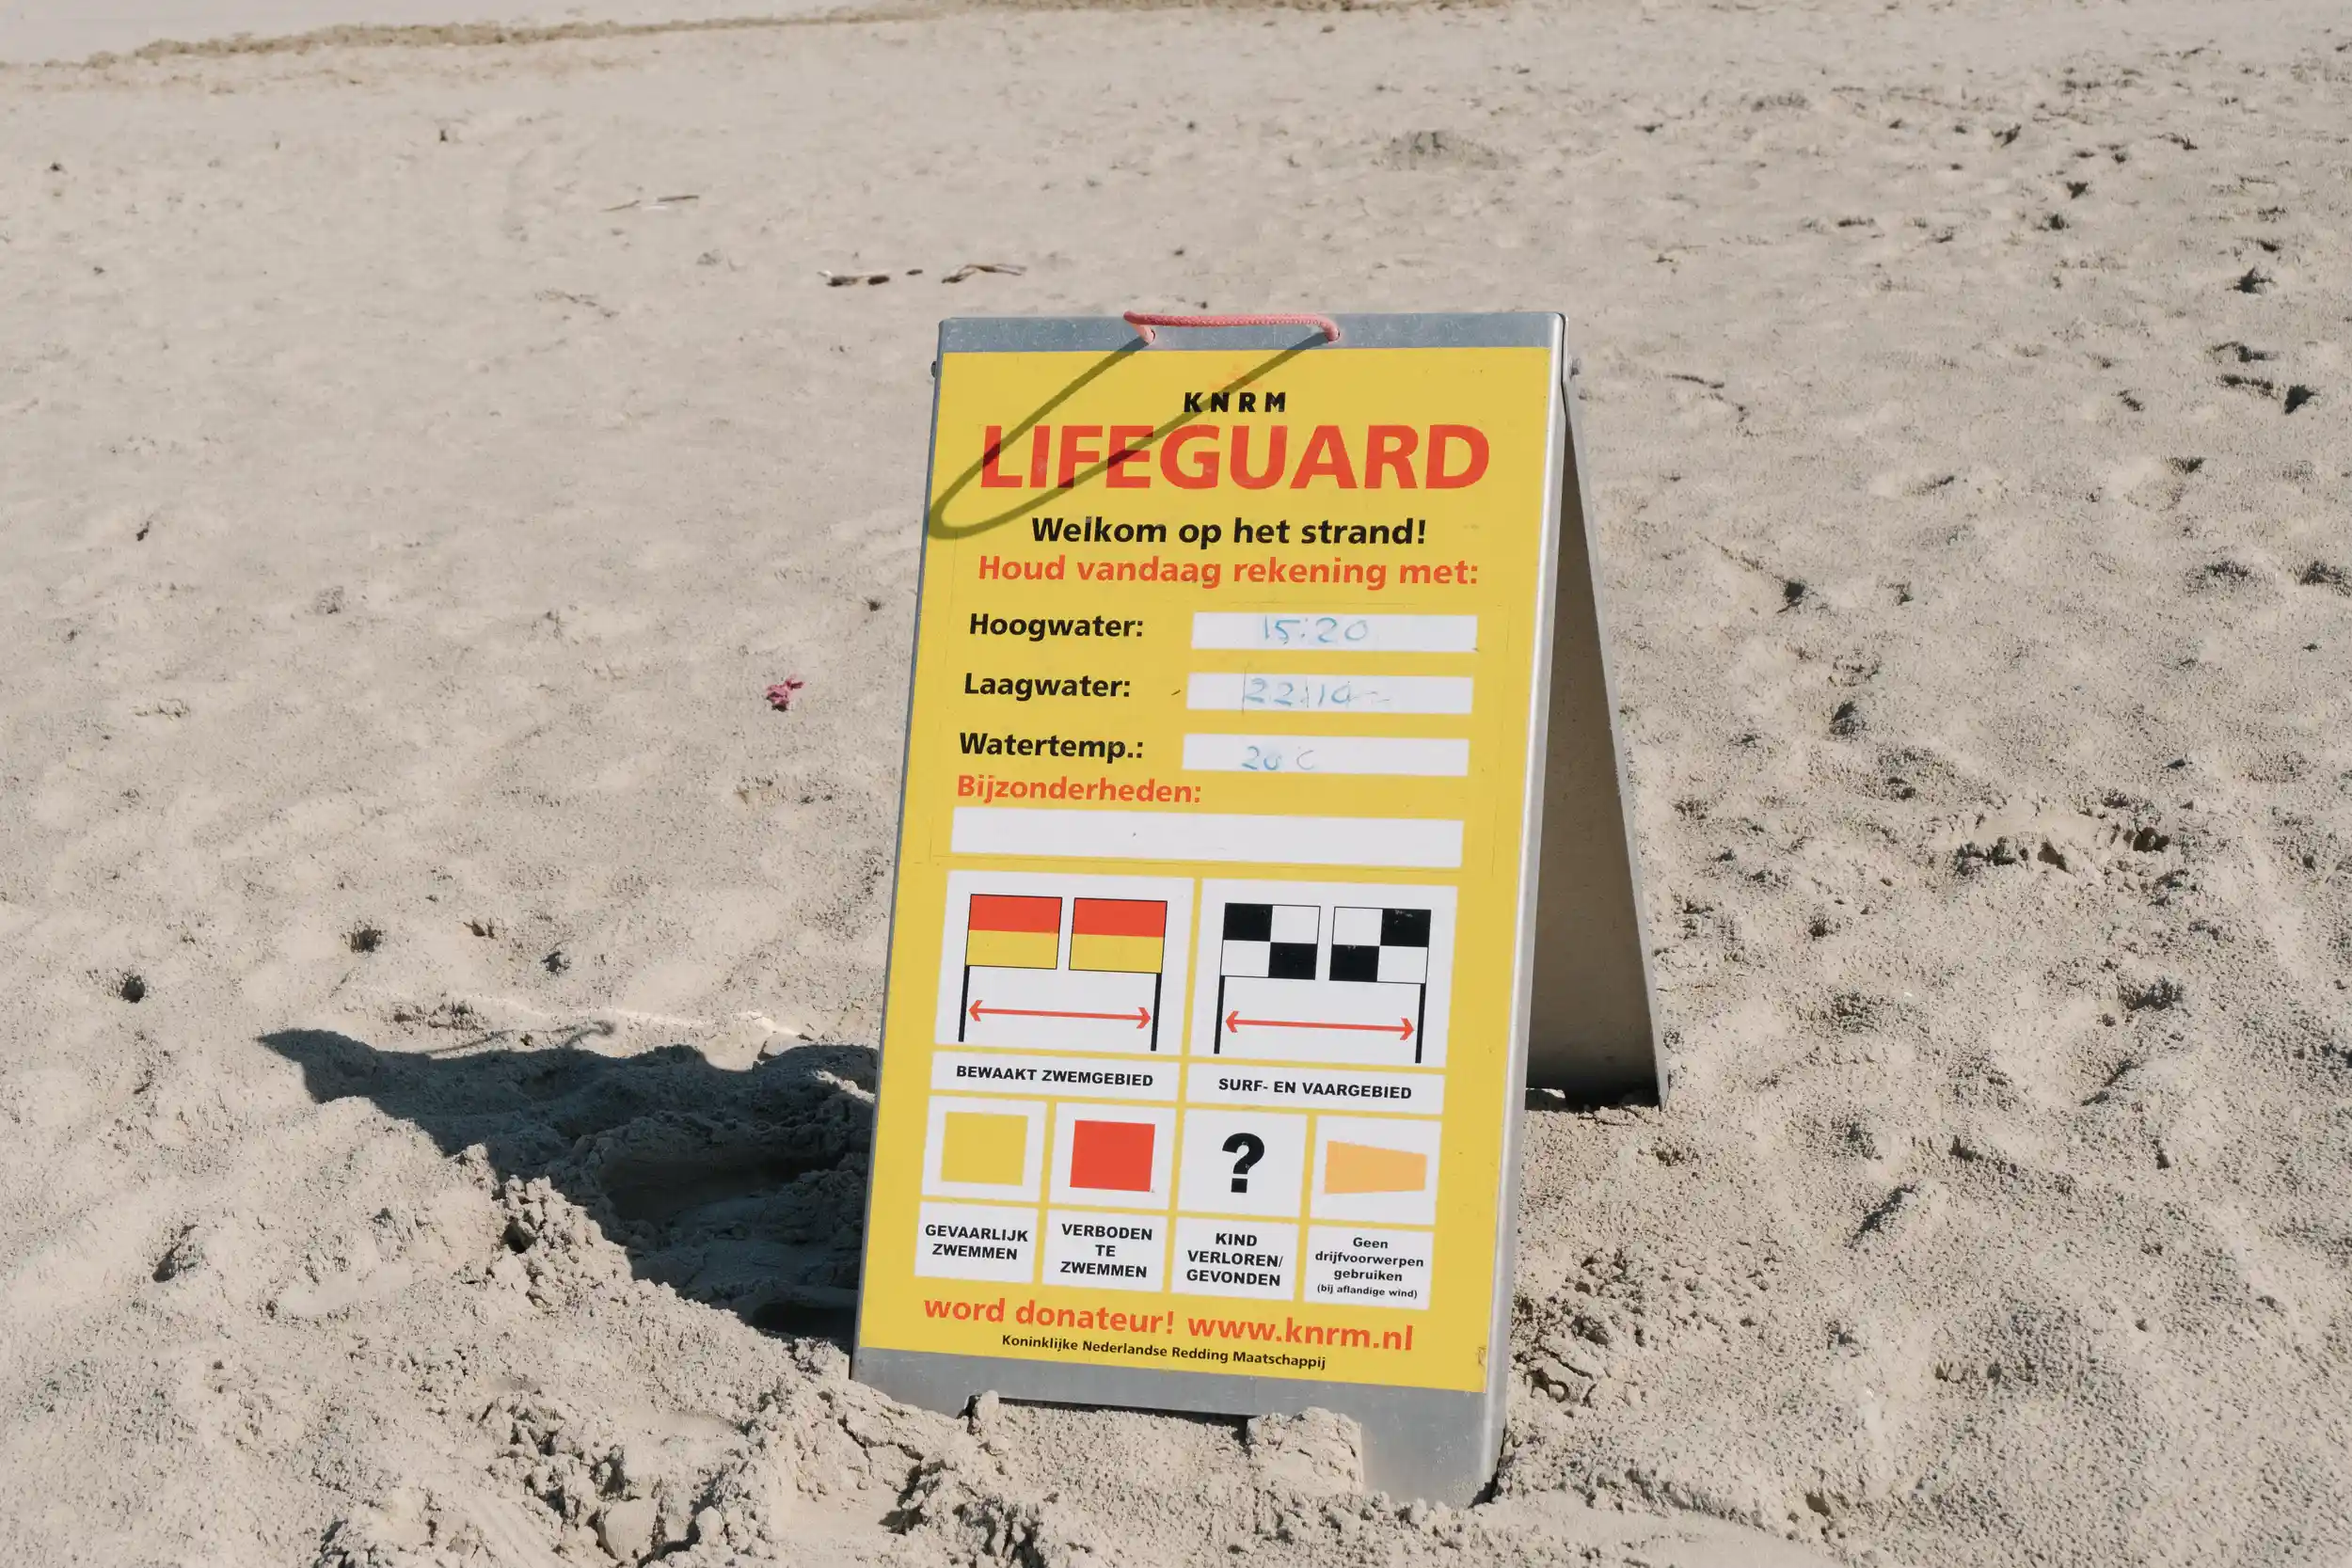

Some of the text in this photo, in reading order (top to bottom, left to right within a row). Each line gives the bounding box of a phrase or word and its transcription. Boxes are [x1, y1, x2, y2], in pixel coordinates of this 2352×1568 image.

[1184, 391, 1286, 414] KNRM
[980, 424, 1490, 490] LIFEGUARD
[1032, 515, 1426, 550] Welkom op het strand!
[978, 553, 1478, 592] Houd vandaag rekening met:
[969, 612, 1143, 642] Hoogwater:
[1263, 615, 1369, 644] 15:20
[964, 673, 1130, 702] Laagwater:
[960, 732, 1143, 765] Watertemp.:
[957, 774, 1201, 804] Bijzonderheden:
[956, 1065, 1153, 1086] BEWAAKT ZWEMGEBIED
[1218, 1078, 1412, 1100] SURF- EN VAARGEBIED
[925, 1224, 1028, 1243] GEVAARLIJK
[1061, 1223, 1152, 1241] VERBODEN
[1215, 1232, 1258, 1247] KIND
[931, 1243, 1018, 1260] ZWEMMEN
[1095, 1244, 1116, 1258] TE
[1353, 1237, 1389, 1249] Geen
[1059, 1260, 1147, 1278] ZWEMMEN
[1187, 1249, 1283, 1268] VERLOREN/
[1314, 1250, 1424, 1269] drijfvoorwerpen
[1186, 1269, 1280, 1287] GEVONDEN
[1334, 1268, 1403, 1282] gebruiken
[1317, 1284, 1418, 1299] (bij aflandige wind)
[925, 1297, 1413, 1351] word donateur! www.knrm.nl
[1002, 1335, 1326, 1370] Koninklijke Nederlandse Redding Maatschappij
